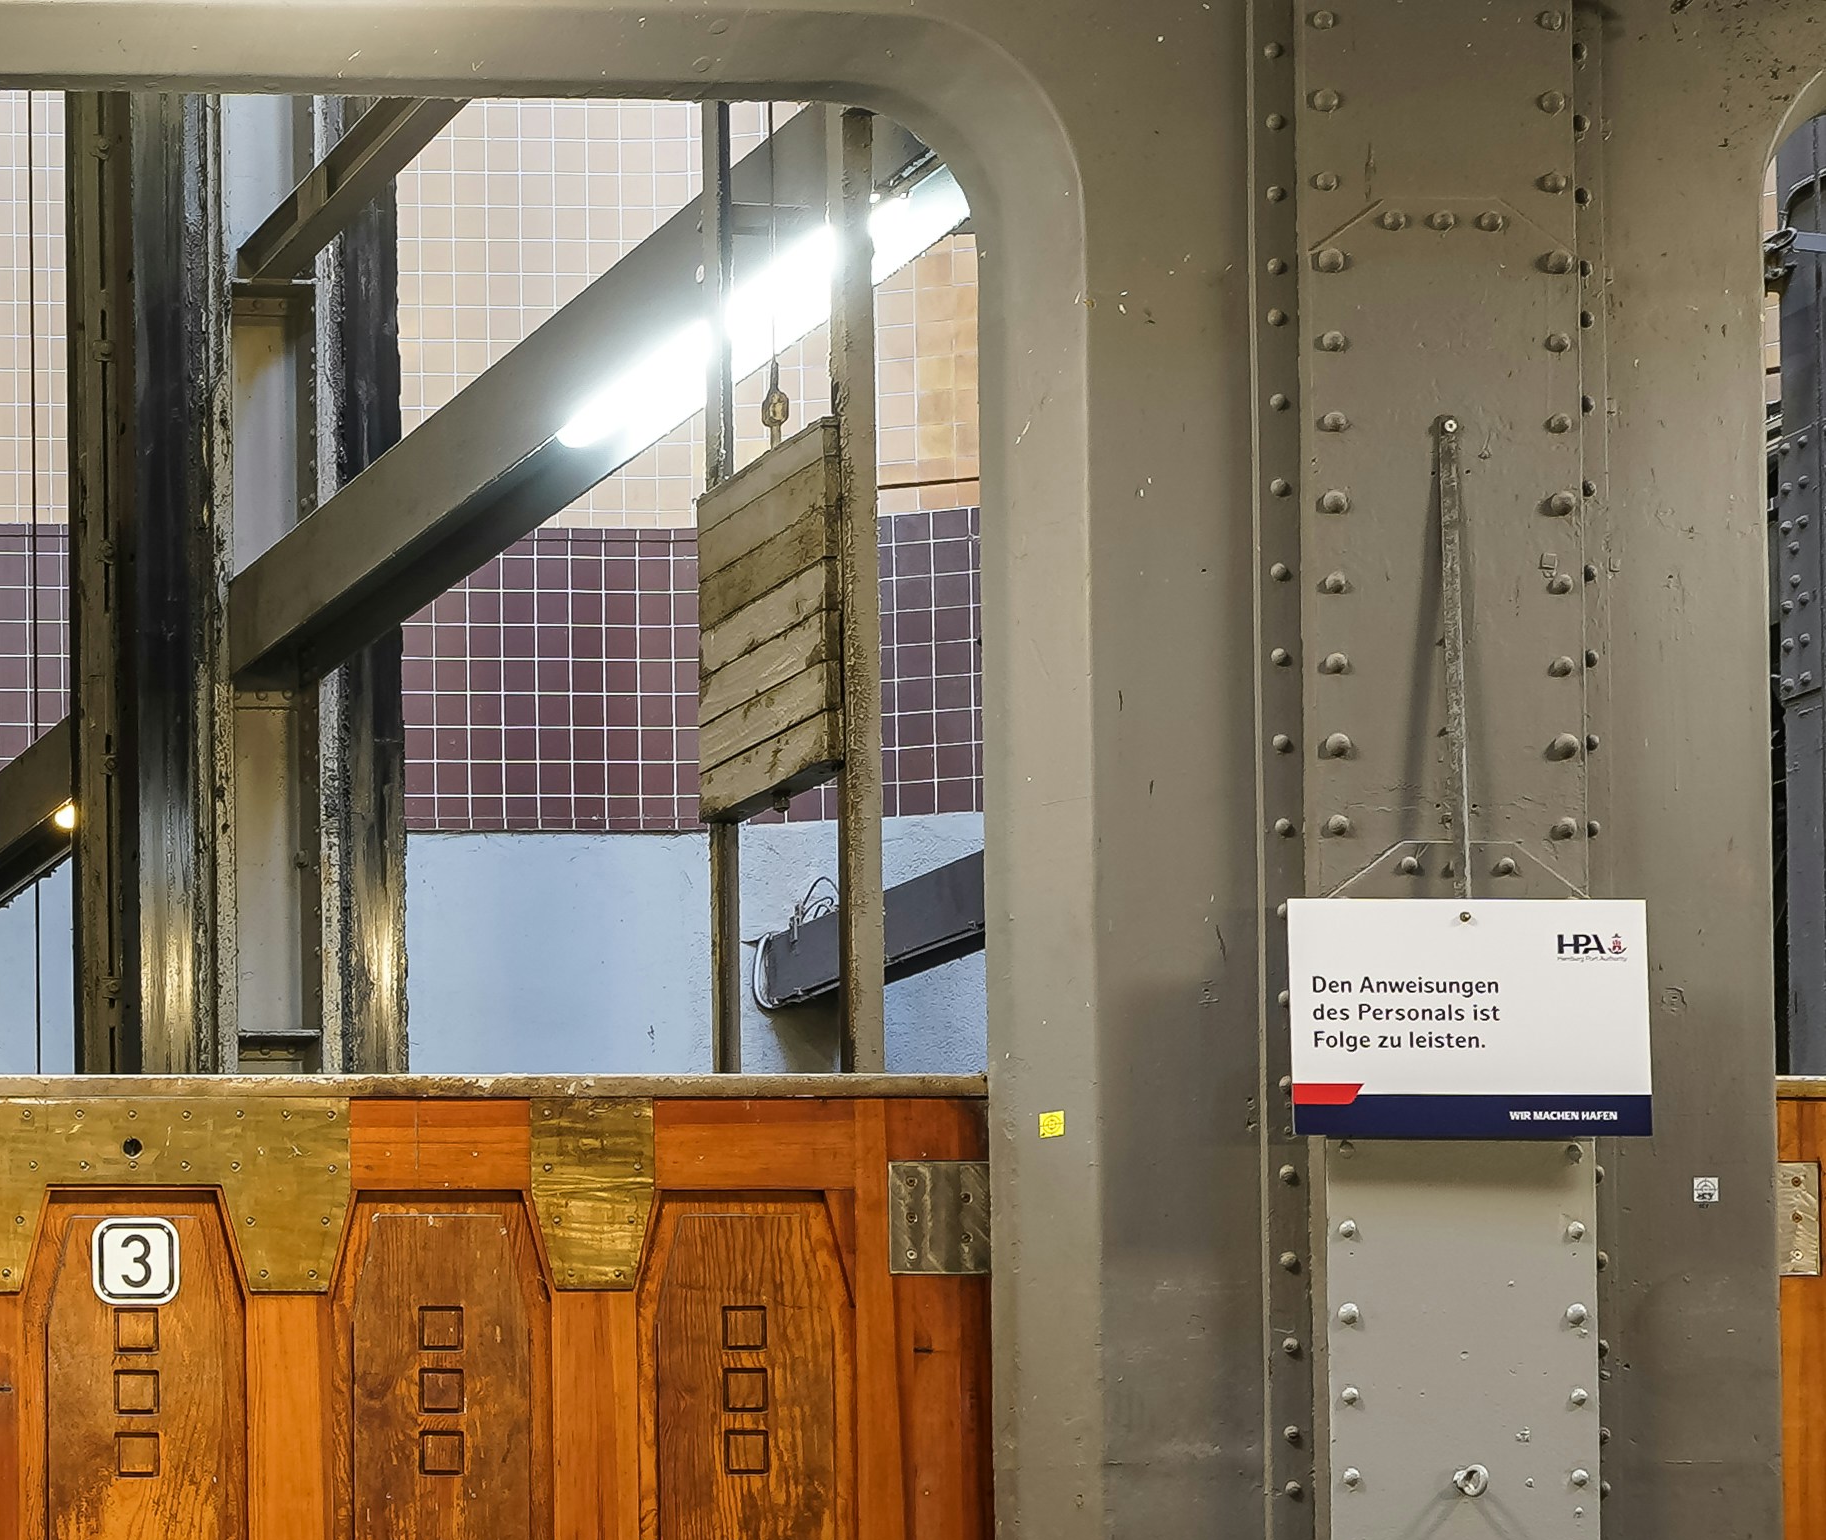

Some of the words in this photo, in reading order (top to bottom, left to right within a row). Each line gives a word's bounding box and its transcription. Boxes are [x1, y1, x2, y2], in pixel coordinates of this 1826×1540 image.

[1557, 934, 1606, 955] HPA
[1312, 976, 1352, 995] Den
[1359, 976, 1499, 998] Anweisungen
[1312, 1003, 1350, 1021] des
[1358, 1003, 1465, 1022] Personals
[1472, 1004, 1501, 1022] ist
[1313, 1030, 1371, 1053] Folge
[1377, 1035, 1402, 1049] zu
[1409, 1031, 1486, 1049] leisten.
[1509, 1110, 1532, 1121] WIR
[1533, 1110, 1580, 1121] MACHEN
[1581, 1110, 1618, 1121] HAFEN
[121, 1234, 152, 1288] 3
